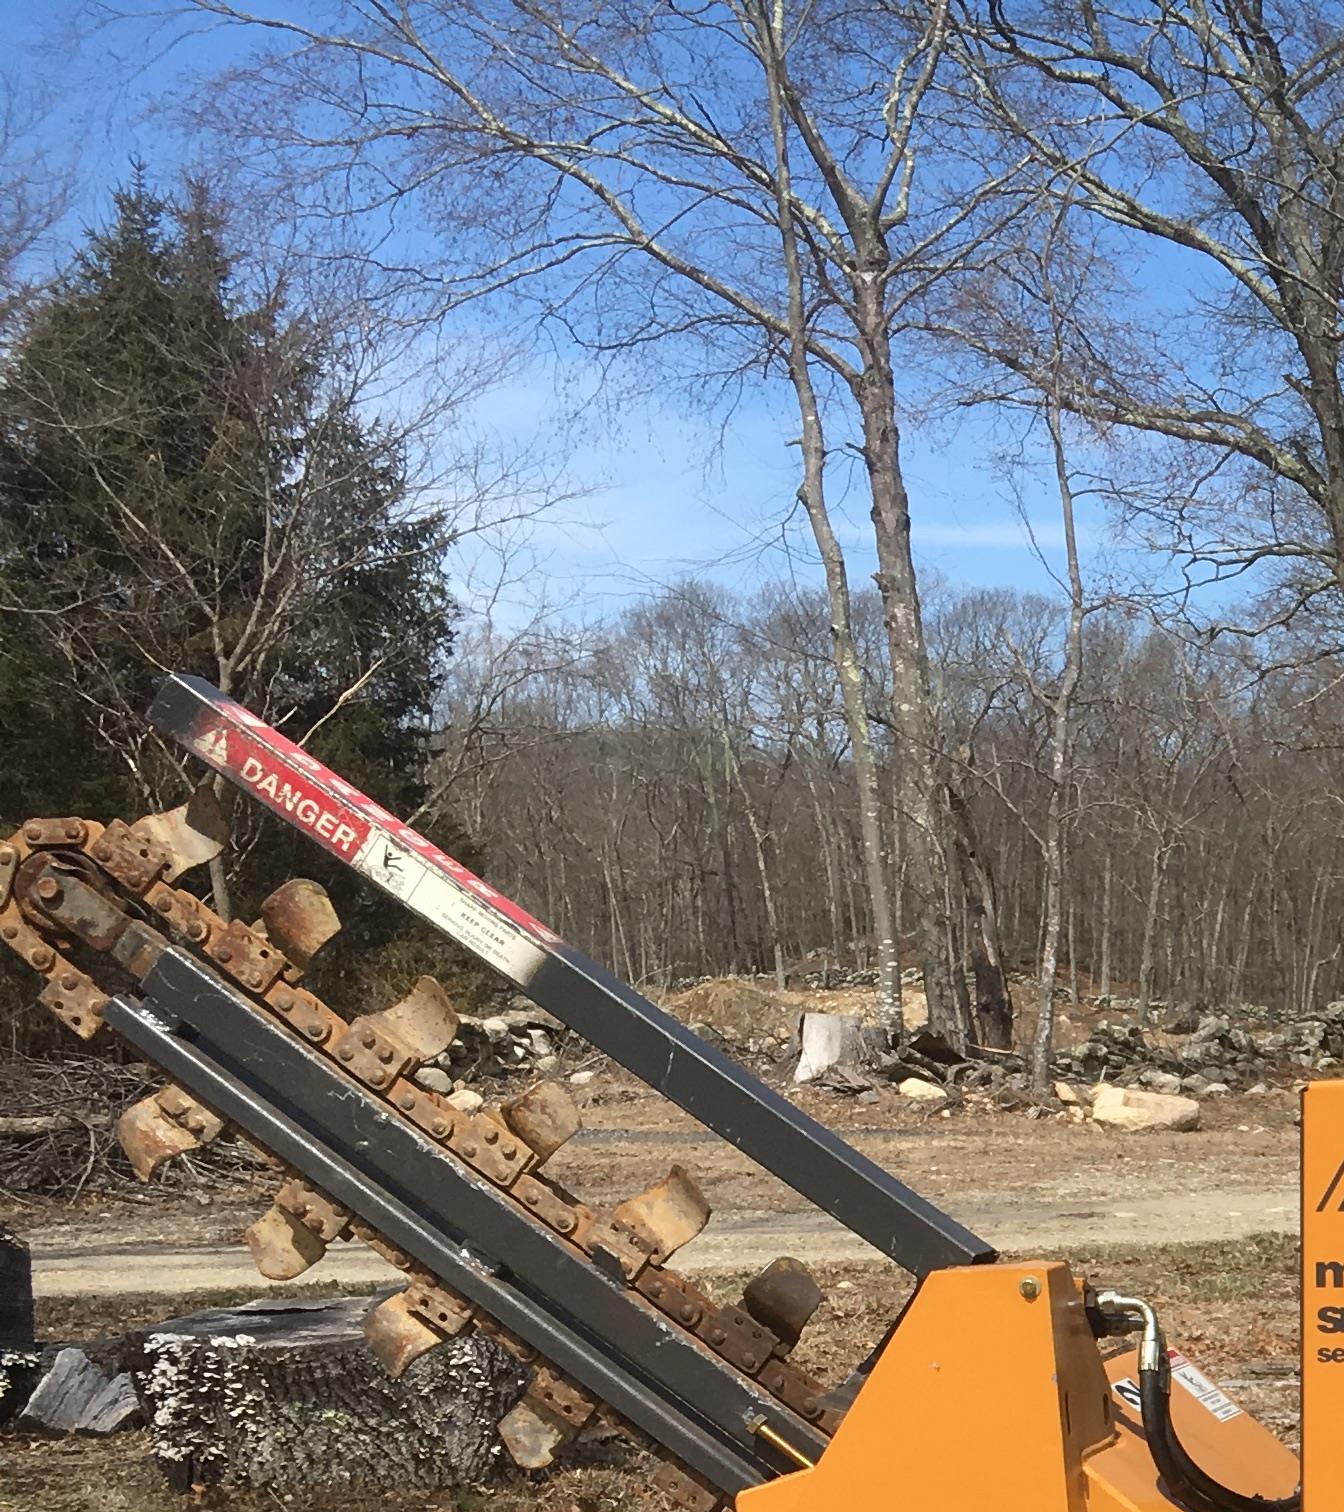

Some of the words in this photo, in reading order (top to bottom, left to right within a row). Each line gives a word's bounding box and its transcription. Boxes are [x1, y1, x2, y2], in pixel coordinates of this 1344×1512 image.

[240, 757, 357, 852] DANGER
[461, 912, 480, 926] KEEP
[480, 926, 505, 946] CLEAR
